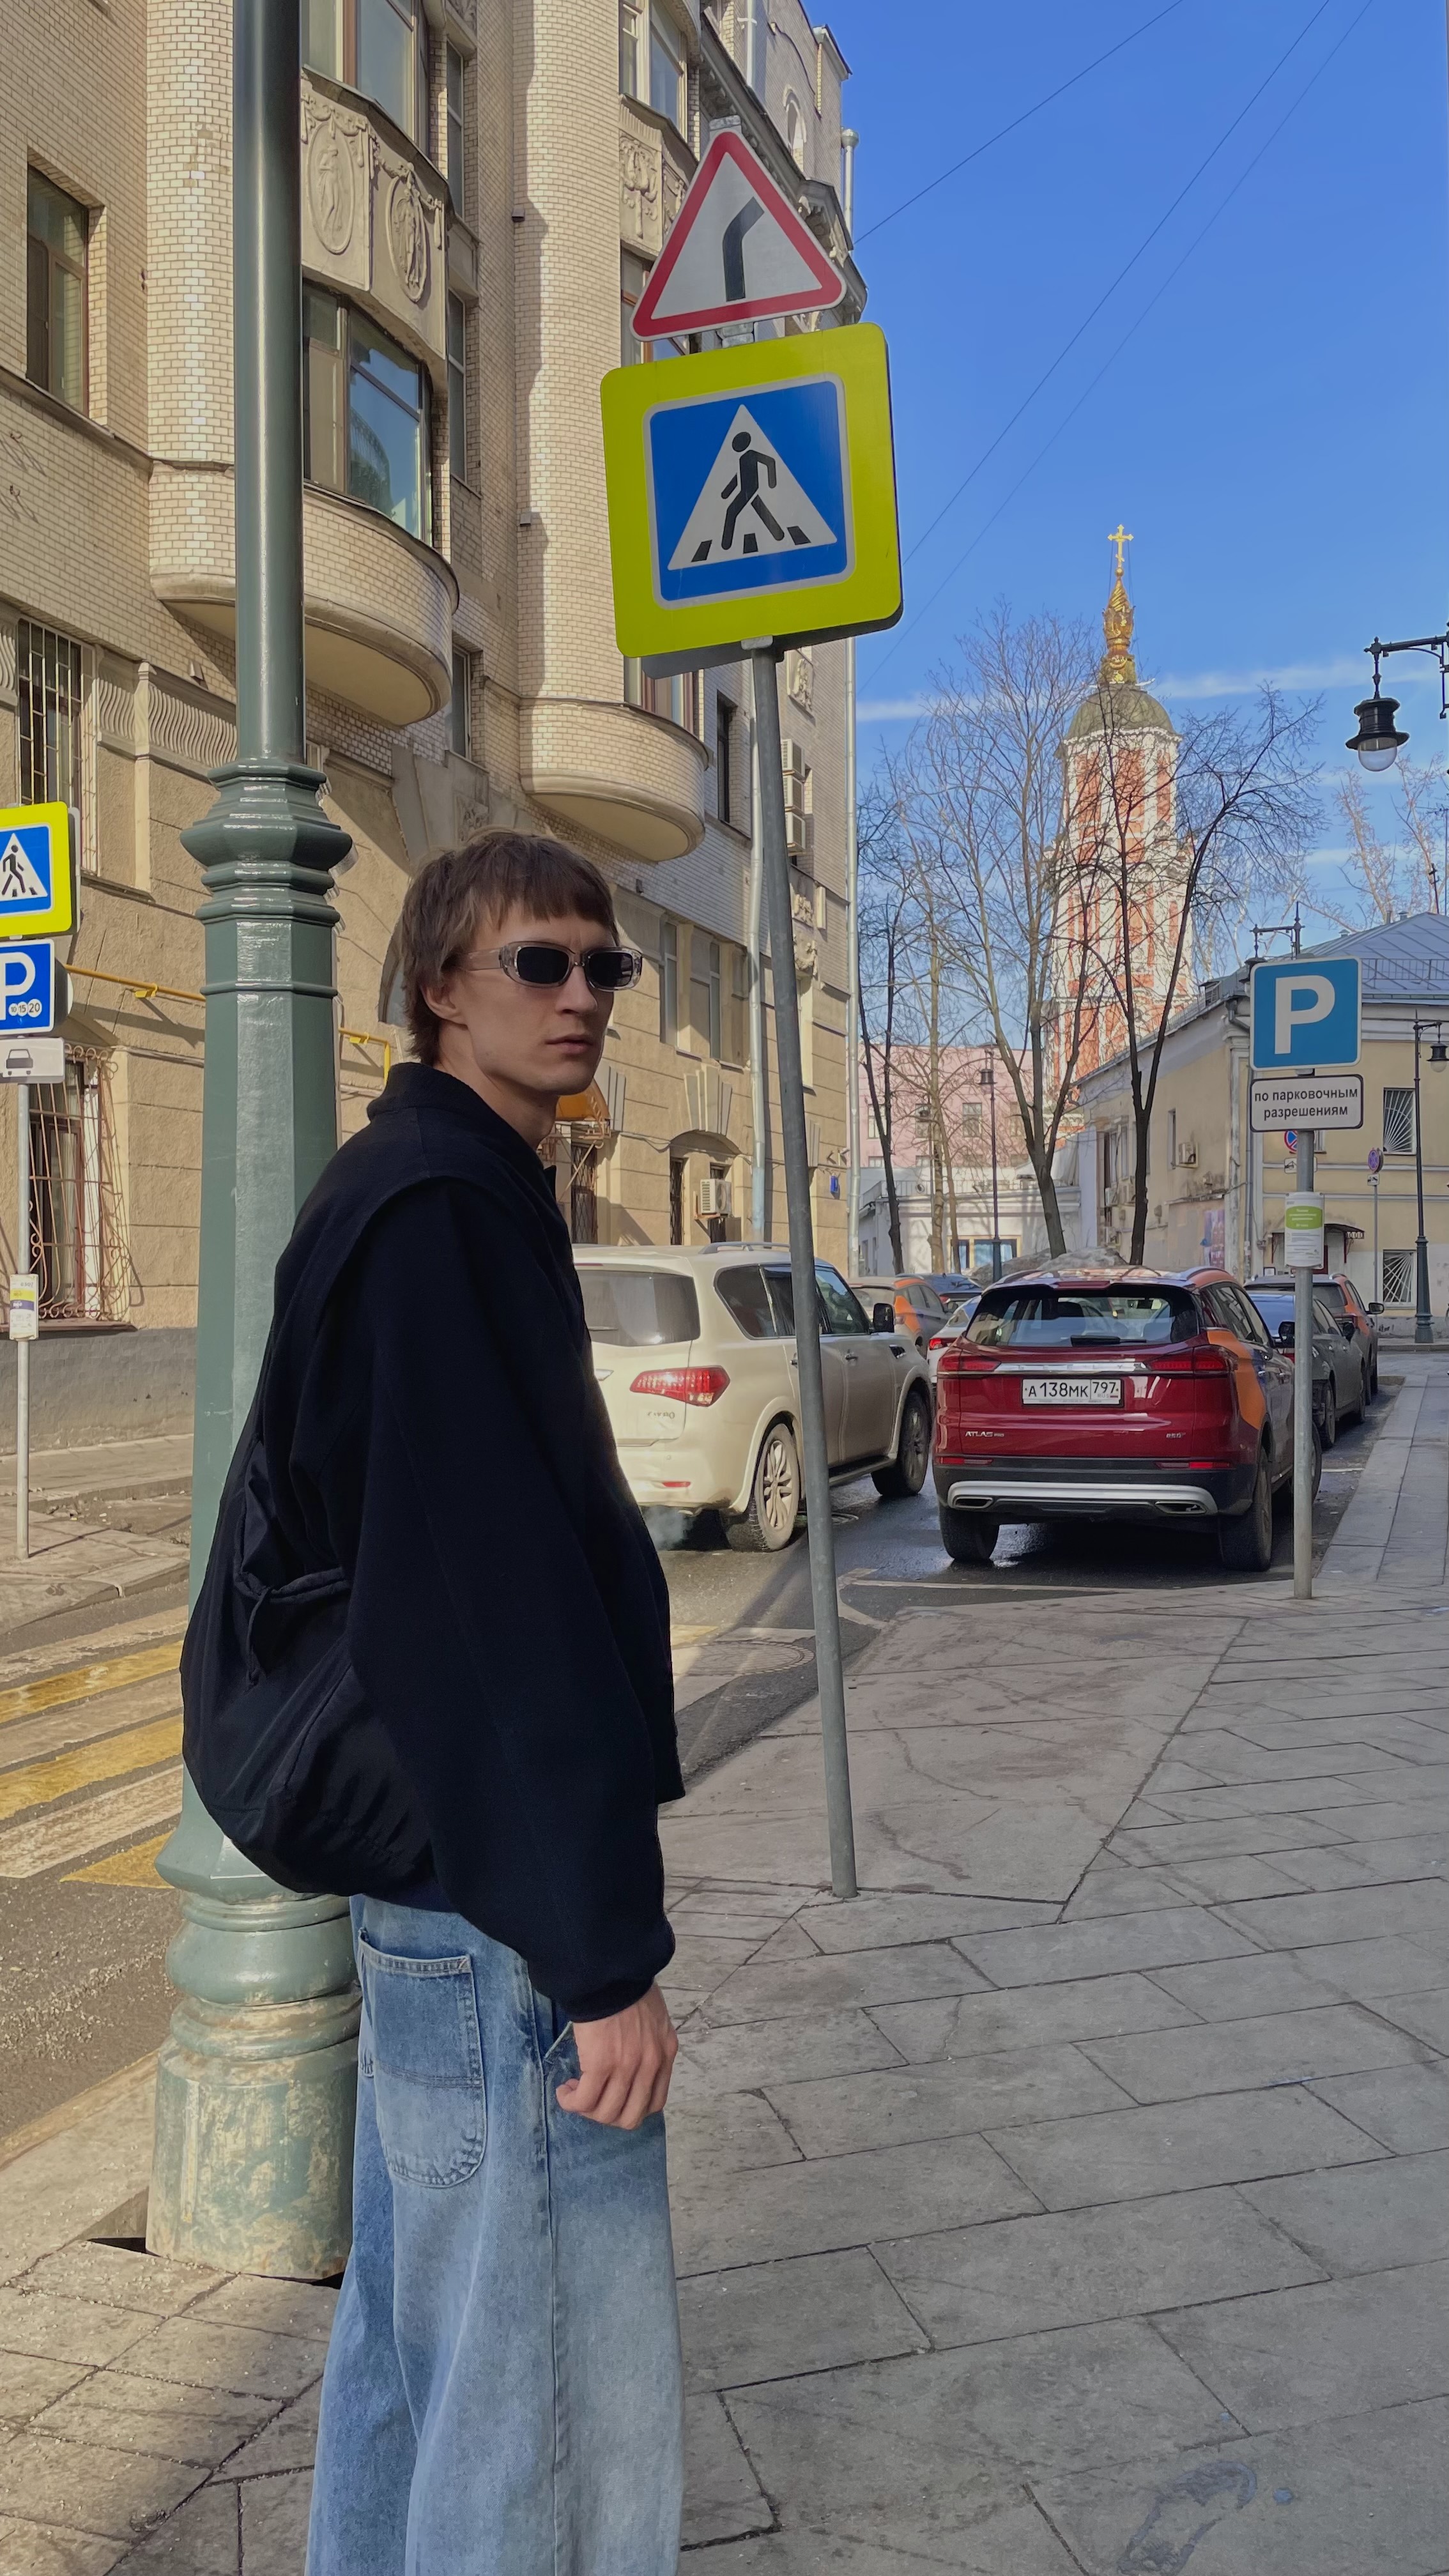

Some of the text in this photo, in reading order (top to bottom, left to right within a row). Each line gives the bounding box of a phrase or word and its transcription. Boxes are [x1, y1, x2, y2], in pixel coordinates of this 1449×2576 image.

[0, 952, 36, 1020] P
[19, 1004, 26, 1013] 15
[29, 1002, 40, 1013] 20
[1274, 974, 1335, 1055] P
[1254, 1088, 1358, 1103] по парковочным
[1264, 1106, 1348, 1121] разрешениям
[1092, 1381, 1117, 1393] 797
